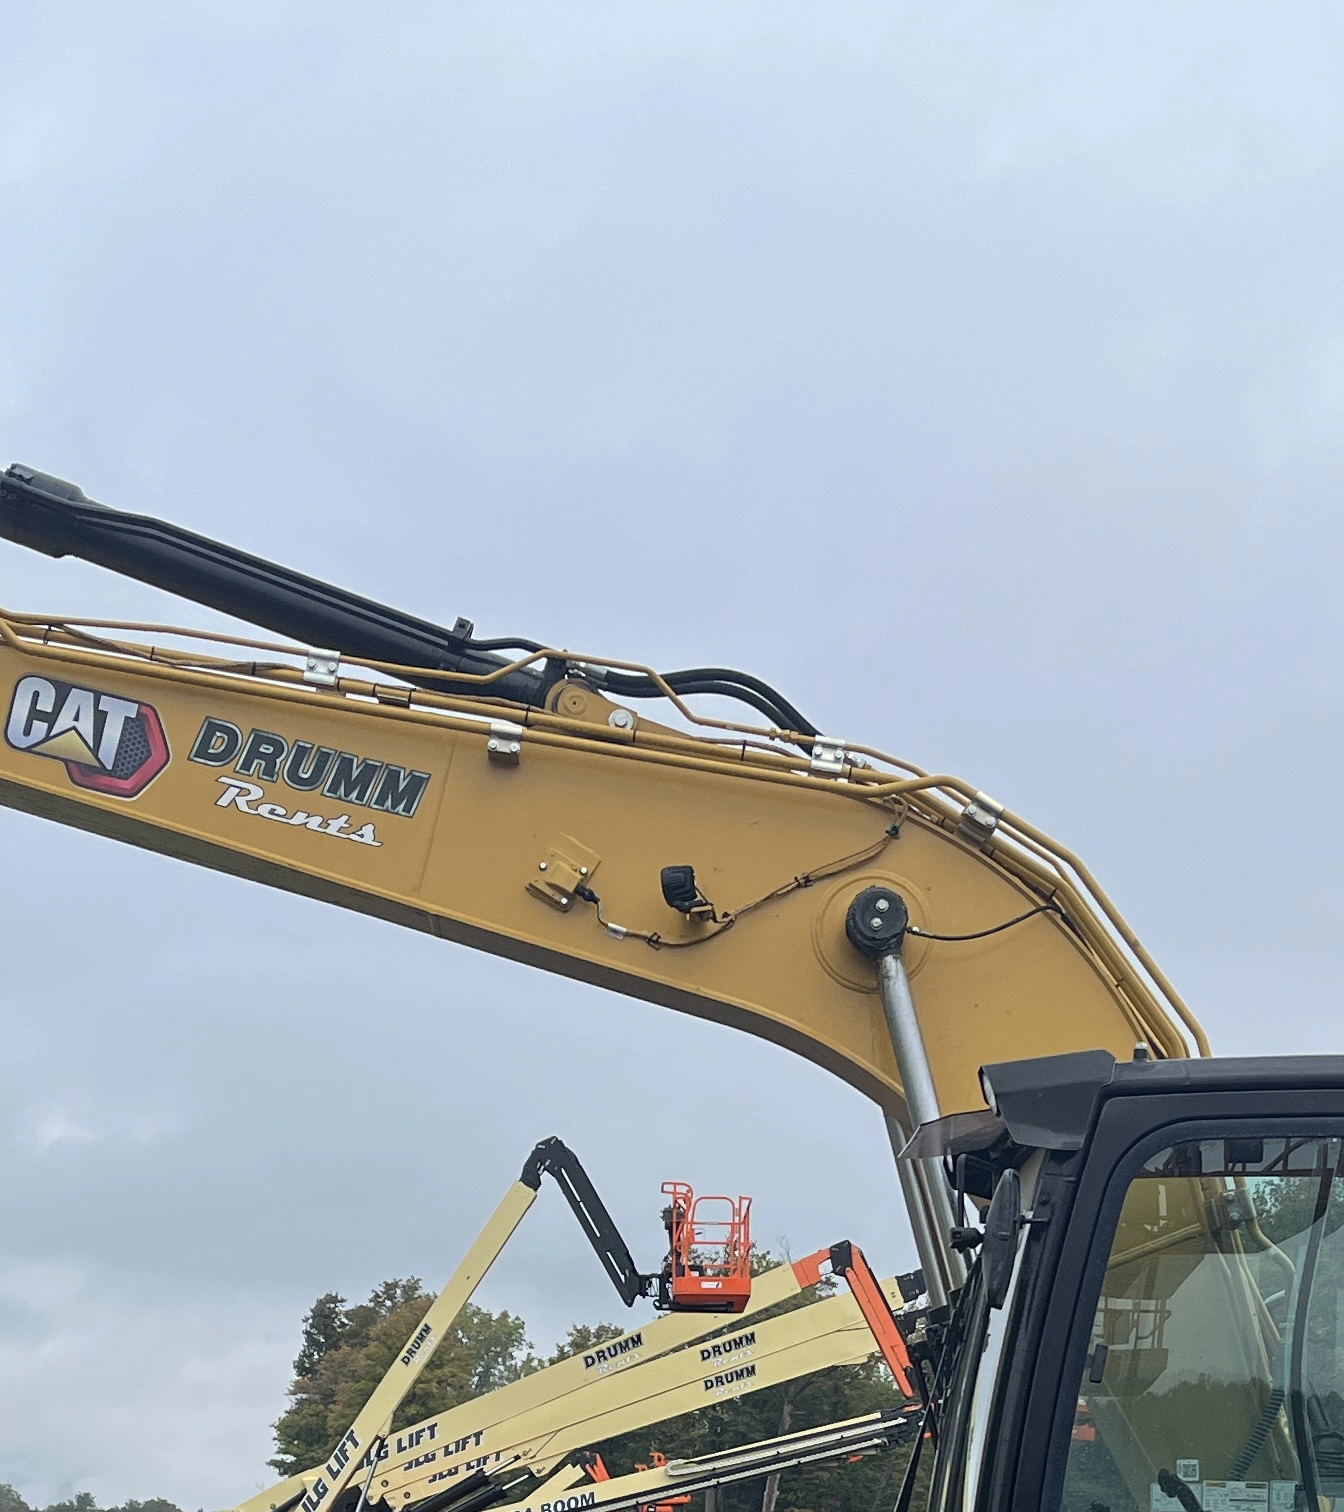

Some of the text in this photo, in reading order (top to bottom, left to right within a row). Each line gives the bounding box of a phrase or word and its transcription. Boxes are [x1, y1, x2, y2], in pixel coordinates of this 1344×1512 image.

[7, 676, 139, 771] CAT
[188, 715, 432, 818] DRUMM
[214, 777, 384, 847] Rents
[401, 1323, 432, 1367] DRUMM
[583, 1332, 643, 1370] DRUMM
[700, 1332, 756, 1361] DRUMM
[704, 1364, 756, 1391] DRUMM
[325, 1430, 360, 1481] LIFT
[397, 1423, 438, 1453] LIFT
[444, 1430, 483, 1457] LIFT
